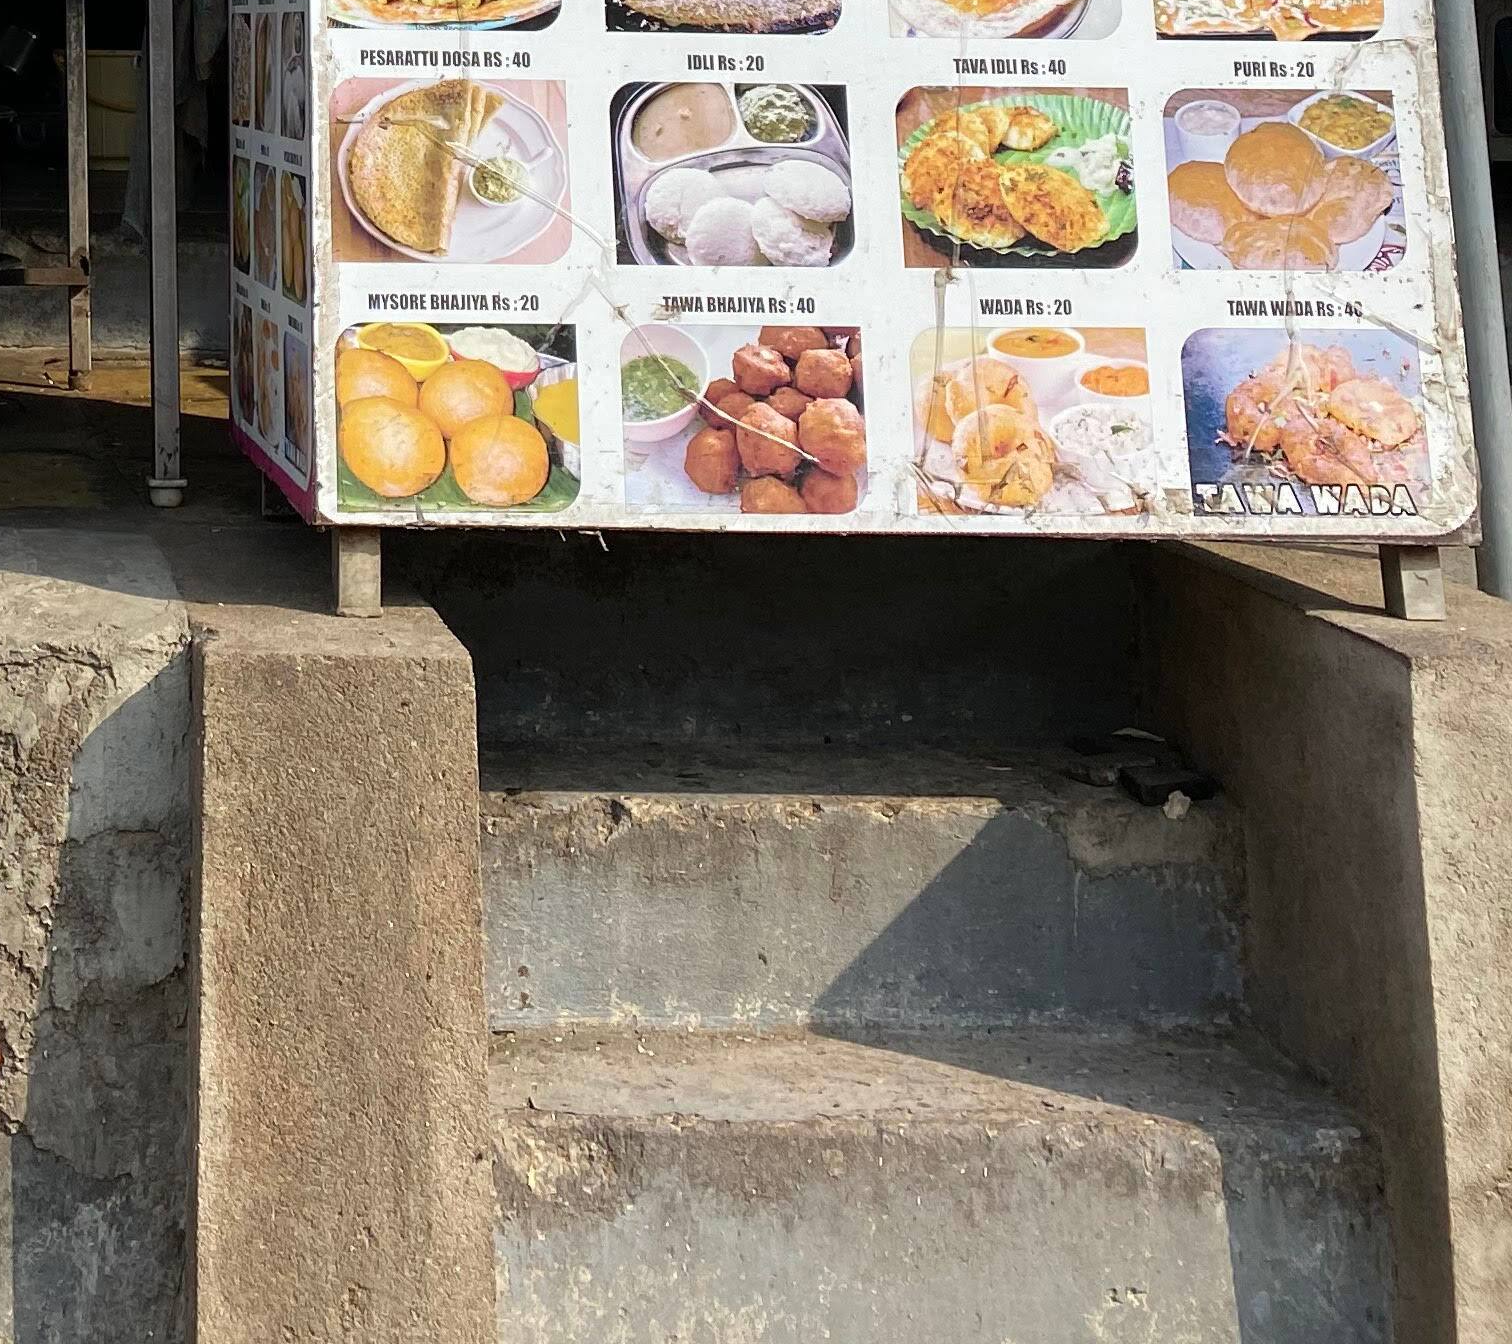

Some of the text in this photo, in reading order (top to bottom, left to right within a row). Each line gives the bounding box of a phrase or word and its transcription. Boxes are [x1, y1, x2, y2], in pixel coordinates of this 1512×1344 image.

[360, 49, 439, 66] PESARATTU
[443, 51, 480, 67] DOSA
[687, 54, 715, 71] IDLI
[953, 58, 988, 74] TAVA
[991, 59, 1018, 75] IDLI
[1234, 61, 1266, 77] PURI
[368, 293, 427, 310] MYSORE
[430, 294, 489, 311] BHAJIYA
[663, 296, 703, 313] TAWA
[707, 297, 766, 313] BHAJIYA
[980, 299, 1023, 315] WADA
[1227, 300, 1268, 317] TAWA
[1270, 300, 1315, 317] WADA
[1310, 483, 1419, 516] WADA
